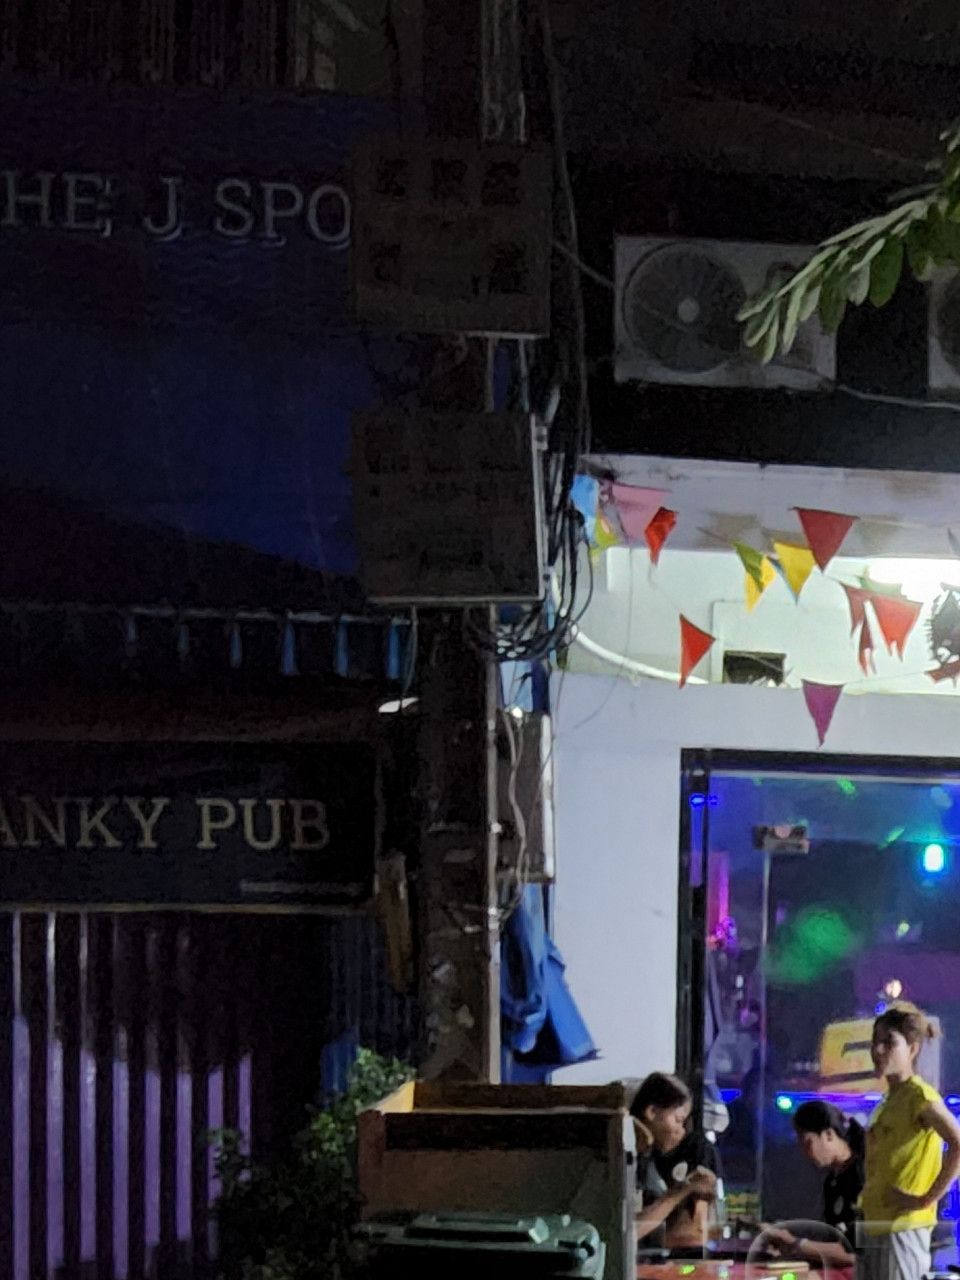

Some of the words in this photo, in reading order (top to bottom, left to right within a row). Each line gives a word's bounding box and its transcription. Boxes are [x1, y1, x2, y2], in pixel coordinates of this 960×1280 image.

[143, 177, 181, 241] J
[213, 178, 350, 249] SPO
[196, 798, 332, 850] PUB
